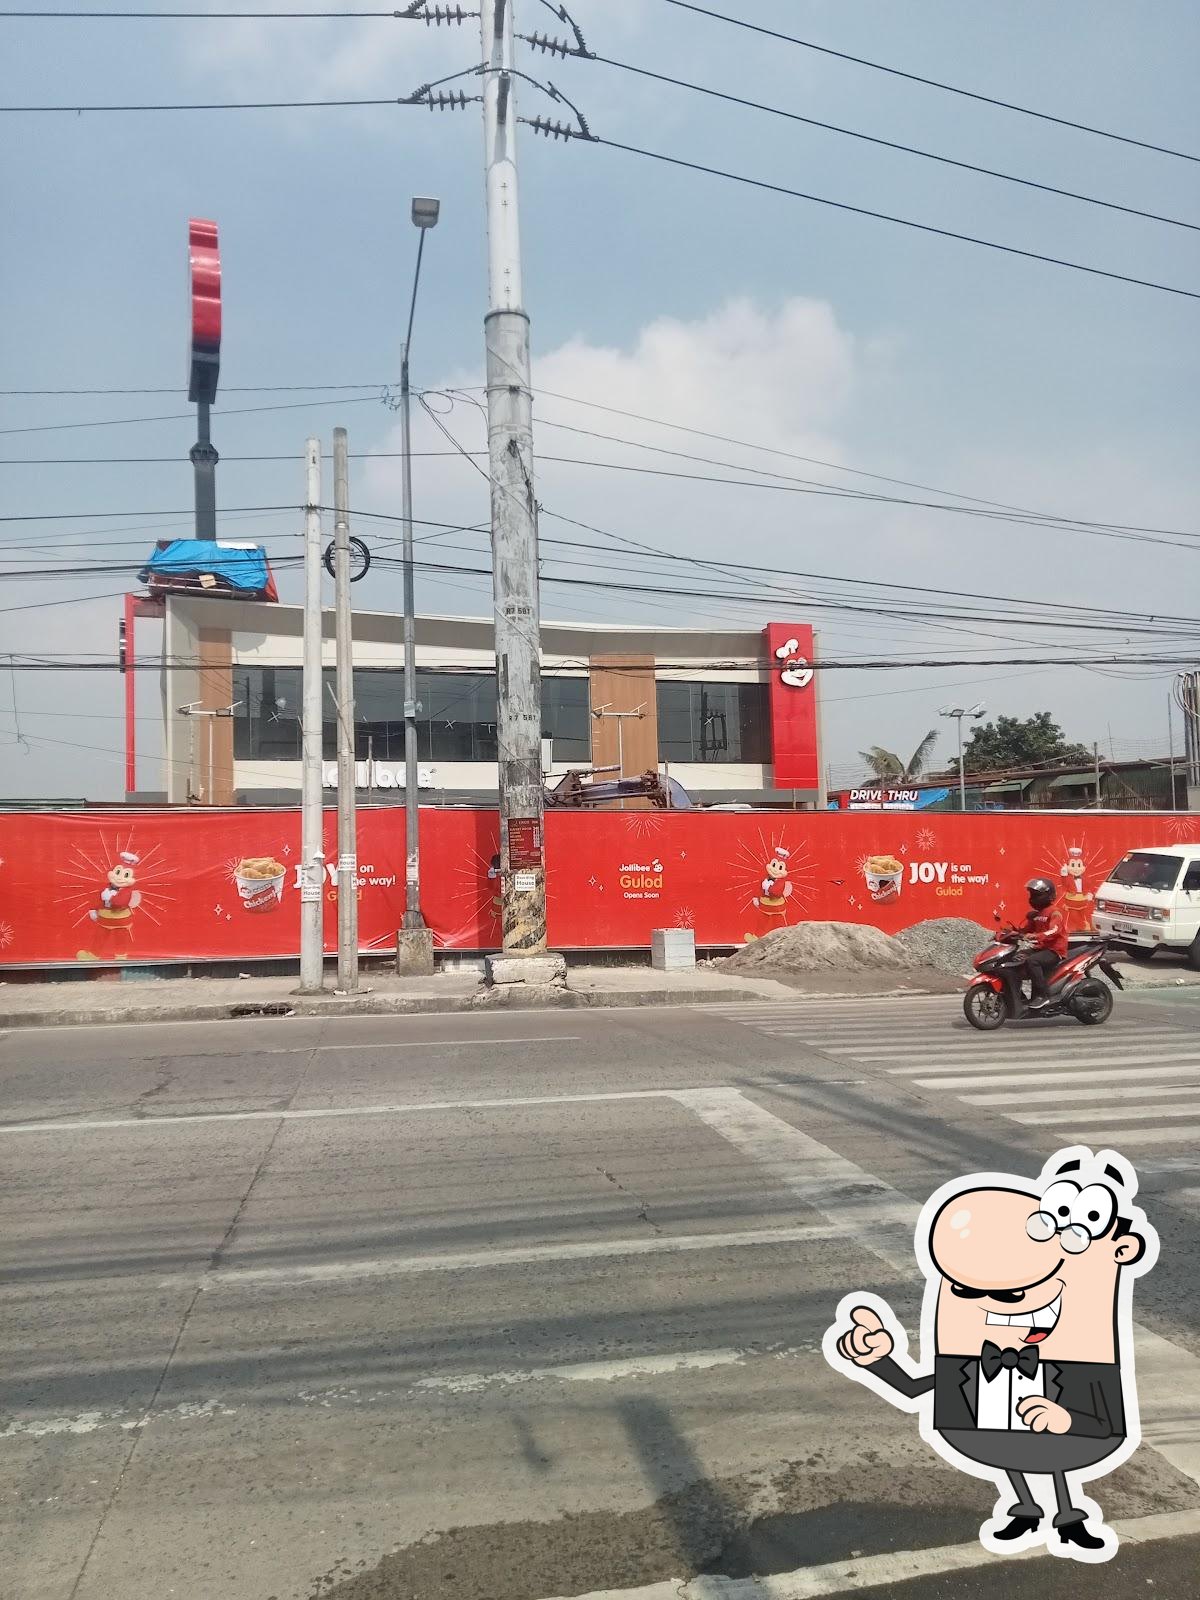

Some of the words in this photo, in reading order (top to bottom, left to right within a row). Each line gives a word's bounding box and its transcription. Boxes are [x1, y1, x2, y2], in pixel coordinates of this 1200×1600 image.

[887, 790, 918, 801] THRU
[359, 864, 374, 873] on
[619, 863, 651, 872] Jollibee
[909, 862, 949, 884] JOY
[951, 863, 958, 872] is
[959, 864, 972, 872] on
[368, 874, 396, 888] way!
[619, 874, 663, 888] Gulod
[951, 874, 966, 883] the
[967, 874, 989, 885] way!
[623, 891, 643, 900] Opens
[643, 891, 660, 899] Soon
[935, 886, 963, 896] Gulod
